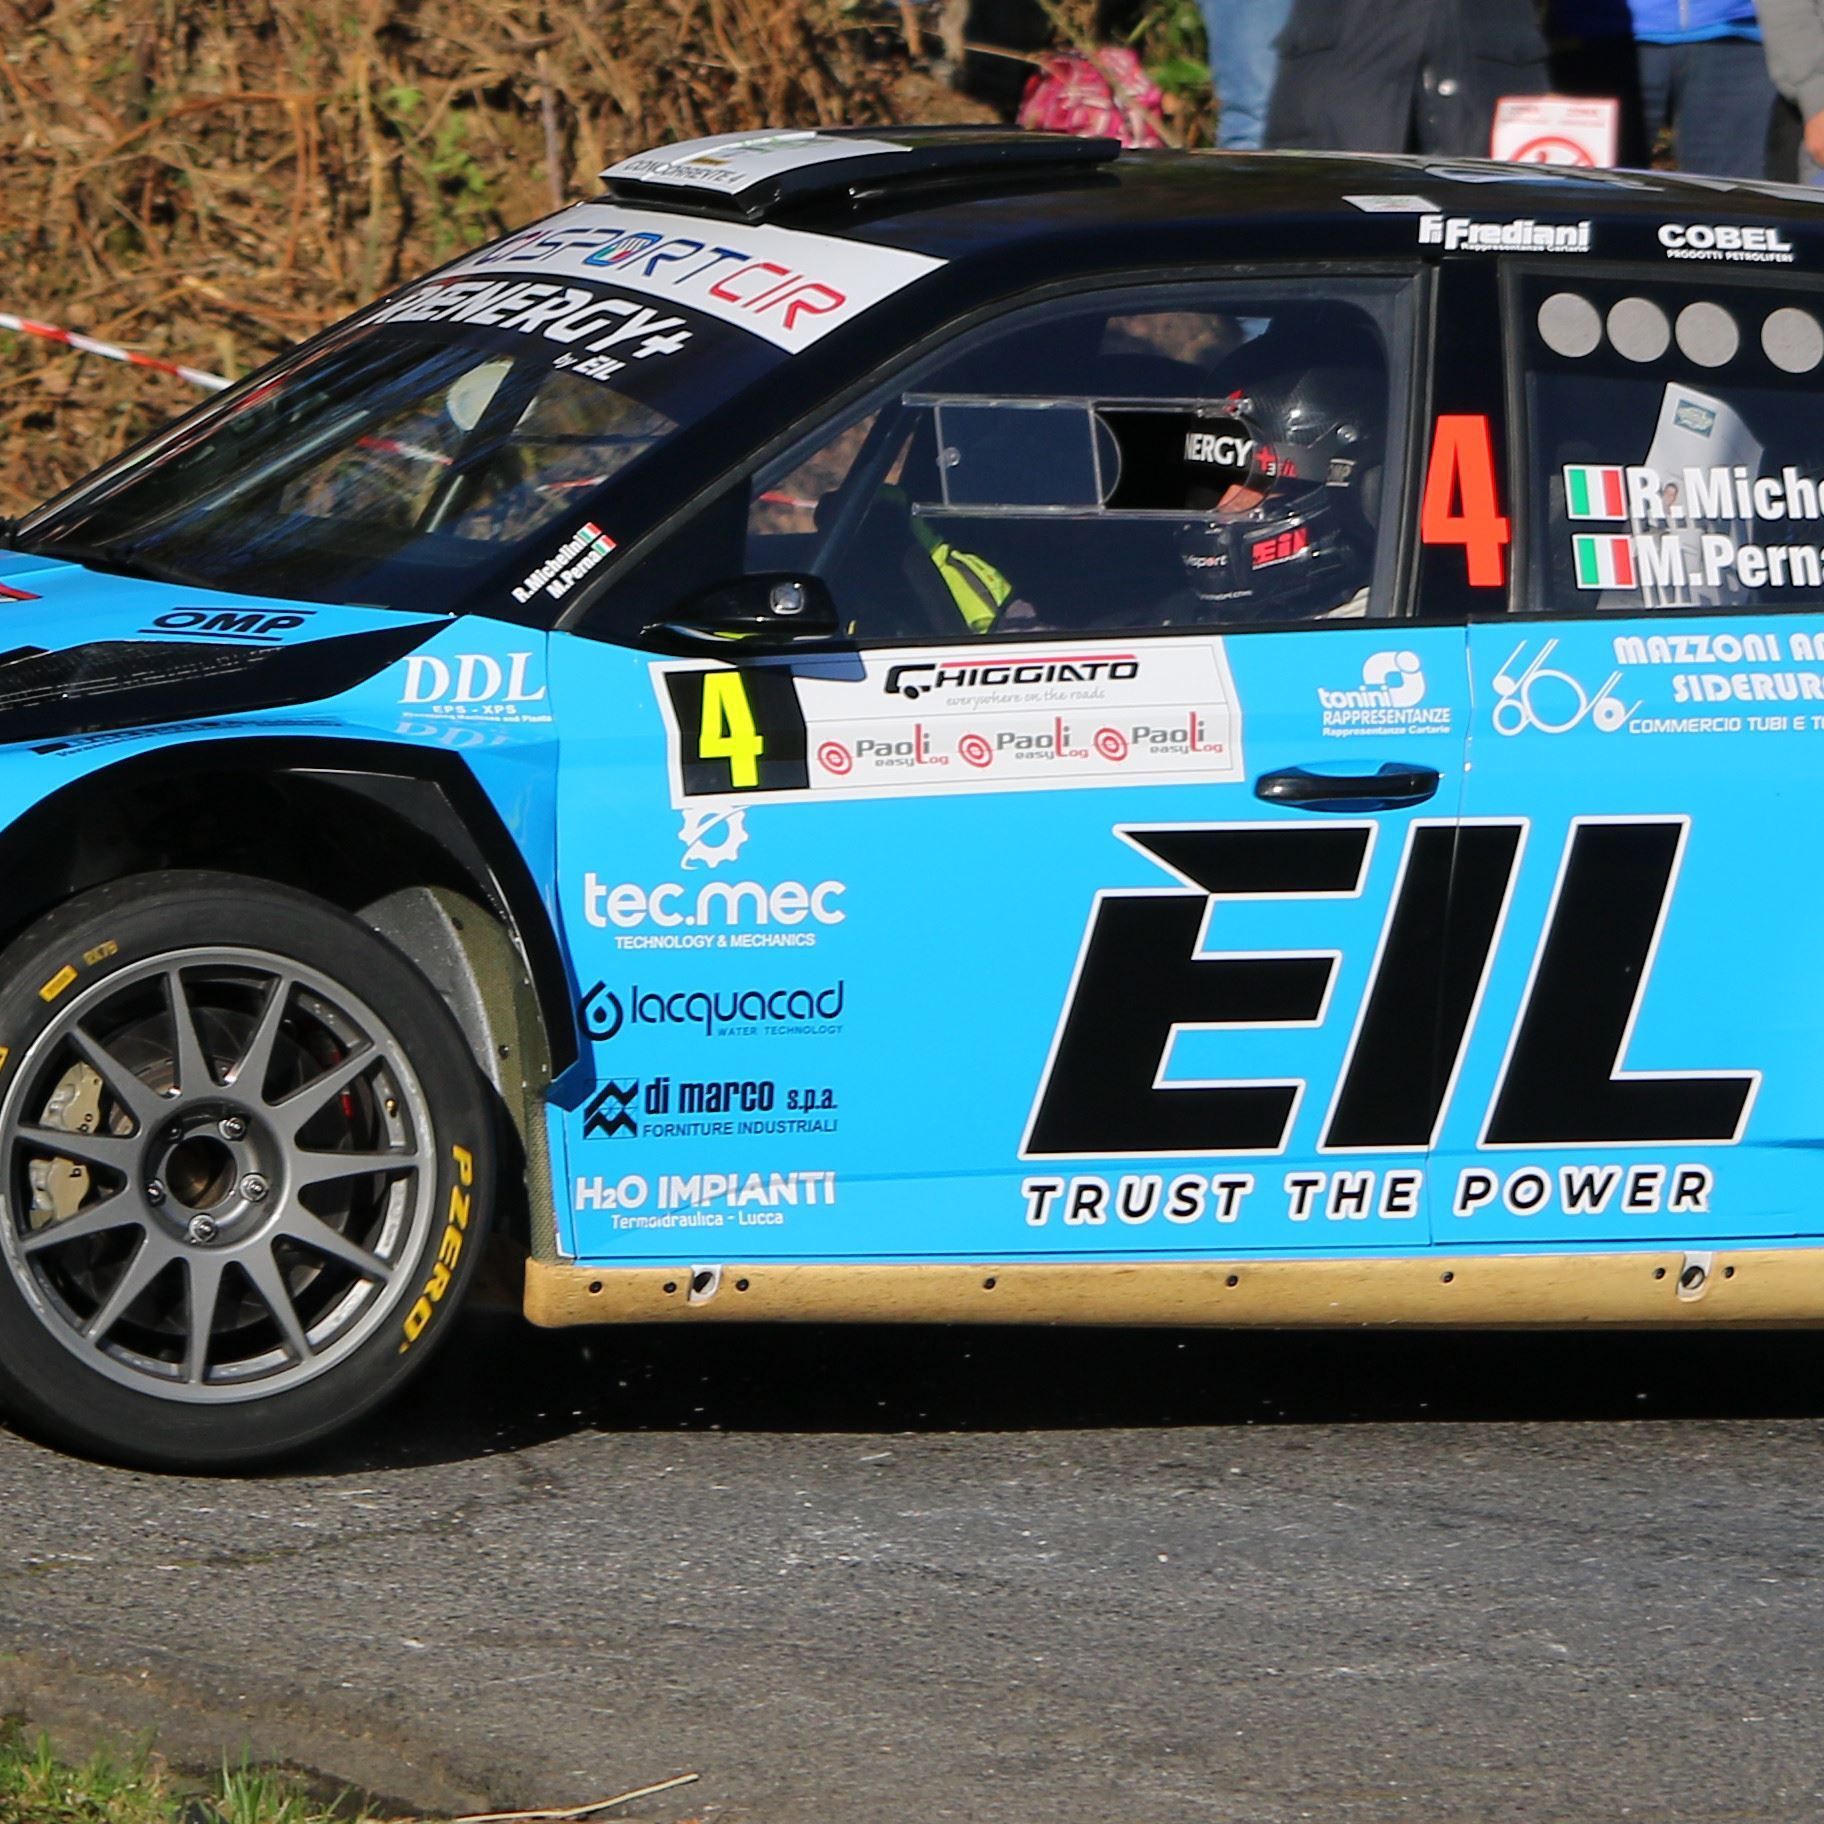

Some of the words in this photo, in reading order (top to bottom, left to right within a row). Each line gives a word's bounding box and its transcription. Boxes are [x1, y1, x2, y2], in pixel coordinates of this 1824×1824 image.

[1444, 219, 1591, 250] Frediani
[1657, 223, 1792, 252] COBEL
[709, 262, 845, 331] CIR
[553, 351, 578, 369] by
[572, 354, 627, 382] EIL
[1421, 414, 1511, 588] 4
[545, 550, 603, 600] M.Perna
[152, 611, 305, 634] OMP
[1613, 636, 1779, 665] MAZZONI
[397, 652, 547, 704] DDL
[432, 705, 467, 715] EPS
[482, 704, 517, 715] XPS
[946, 691, 1023, 711] everywhere
[1025, 693, 1040, 704] on
[1042, 690, 1066, 703] the
[1068, 687, 1106, 701] roads
[1317, 684, 1391, 708] tonini
[698, 672, 764, 788] 4
[1131, 710, 1205, 748] Paoli
[1323, 707, 1451, 725] RAPPRESENTANZE
[1629, 717, 1741, 734] COMMERCIO
[1748, 716, 1788, 732] TUBI
[1792, 717, 1807, 732] E
[856, 723, 930, 759] Paoli
[996, 716, 1070, 754] Paoli
[584, 872, 847, 928] tec.mec
[615, 934, 715, 950] TECHNOLOGY
[716, 935, 727, 948] &
[730, 933, 817, 948] MECHANICS
[1018, 815, 1762, 1161] EIL
[631, 979, 845, 1037] lacquacad
[718, 1026, 758, 1037] WATER
[764, 1024, 844, 1035] TECHNOLOGY
[645, 1077, 670, 1115] di
[679, 1081, 775, 1114] marco
[787, 1088, 838, 1114] s.p.a.
[642, 1122, 733, 1138] FORNITURE
[737, 1119, 838, 1135] INDUSTRIALI
[657, 1171, 837, 1209] IMPIANTI
[1022, 1173, 1254, 1225] TRUST
[1285, 1170, 1426, 1219] THE
[1452, 1165, 1715, 1214] POWER
[611, 1213, 724, 1230] Termoidraulica
[738, 1211, 784, 1226] Lucca
